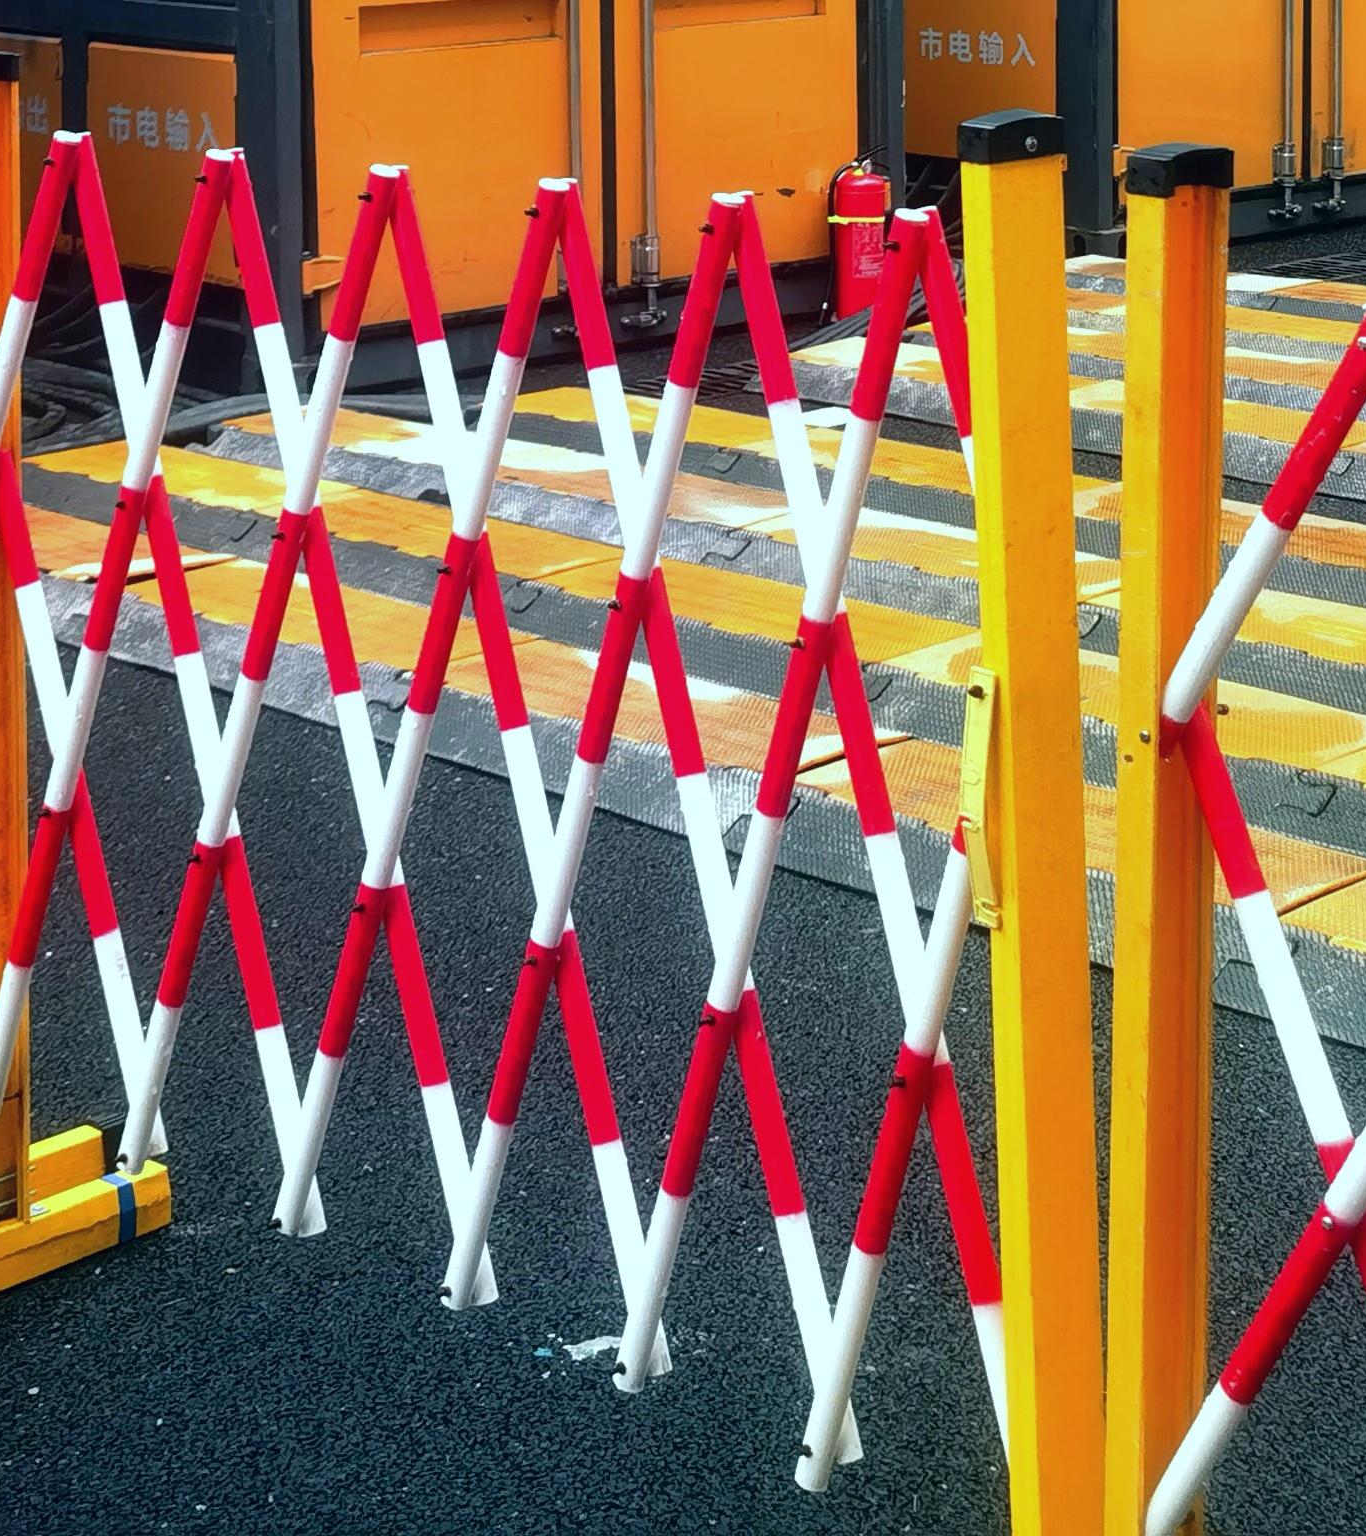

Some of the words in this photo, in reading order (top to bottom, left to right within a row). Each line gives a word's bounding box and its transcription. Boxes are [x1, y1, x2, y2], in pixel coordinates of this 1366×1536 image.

[919, 27, 1036, 66] 市电输入
[106, 102, 219, 152] 市电输入
